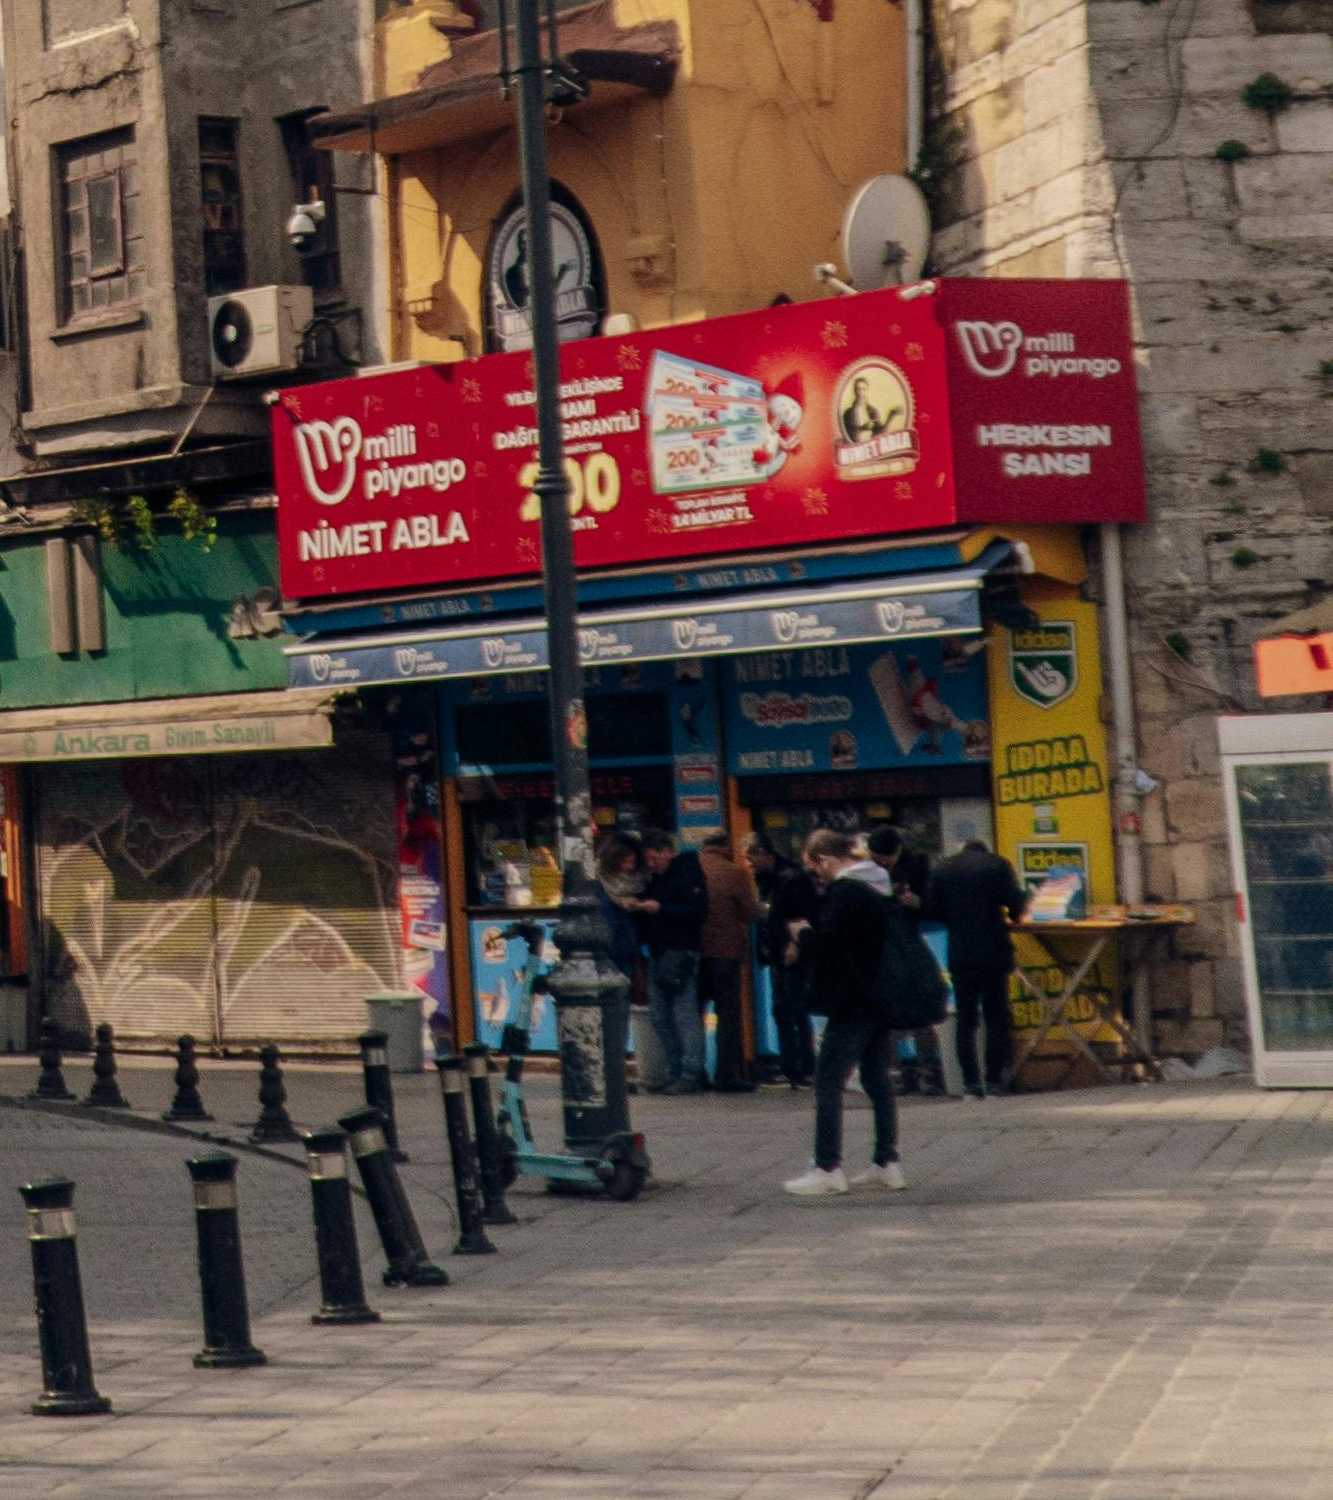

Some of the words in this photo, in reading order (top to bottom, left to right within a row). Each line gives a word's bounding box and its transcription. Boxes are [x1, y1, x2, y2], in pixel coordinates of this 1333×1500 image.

[1026, 331, 1075, 352] milli
[1026, 354, 1121, 378] piyango
[364, 424, 416, 461] milli
[364, 457, 467, 500] piyango
[299, 518, 387, 561] NİMET
[390, 511, 469, 551] ABLA
[54, 731, 151, 756] Ankara
[1000, 766, 1099, 801] BURADA
